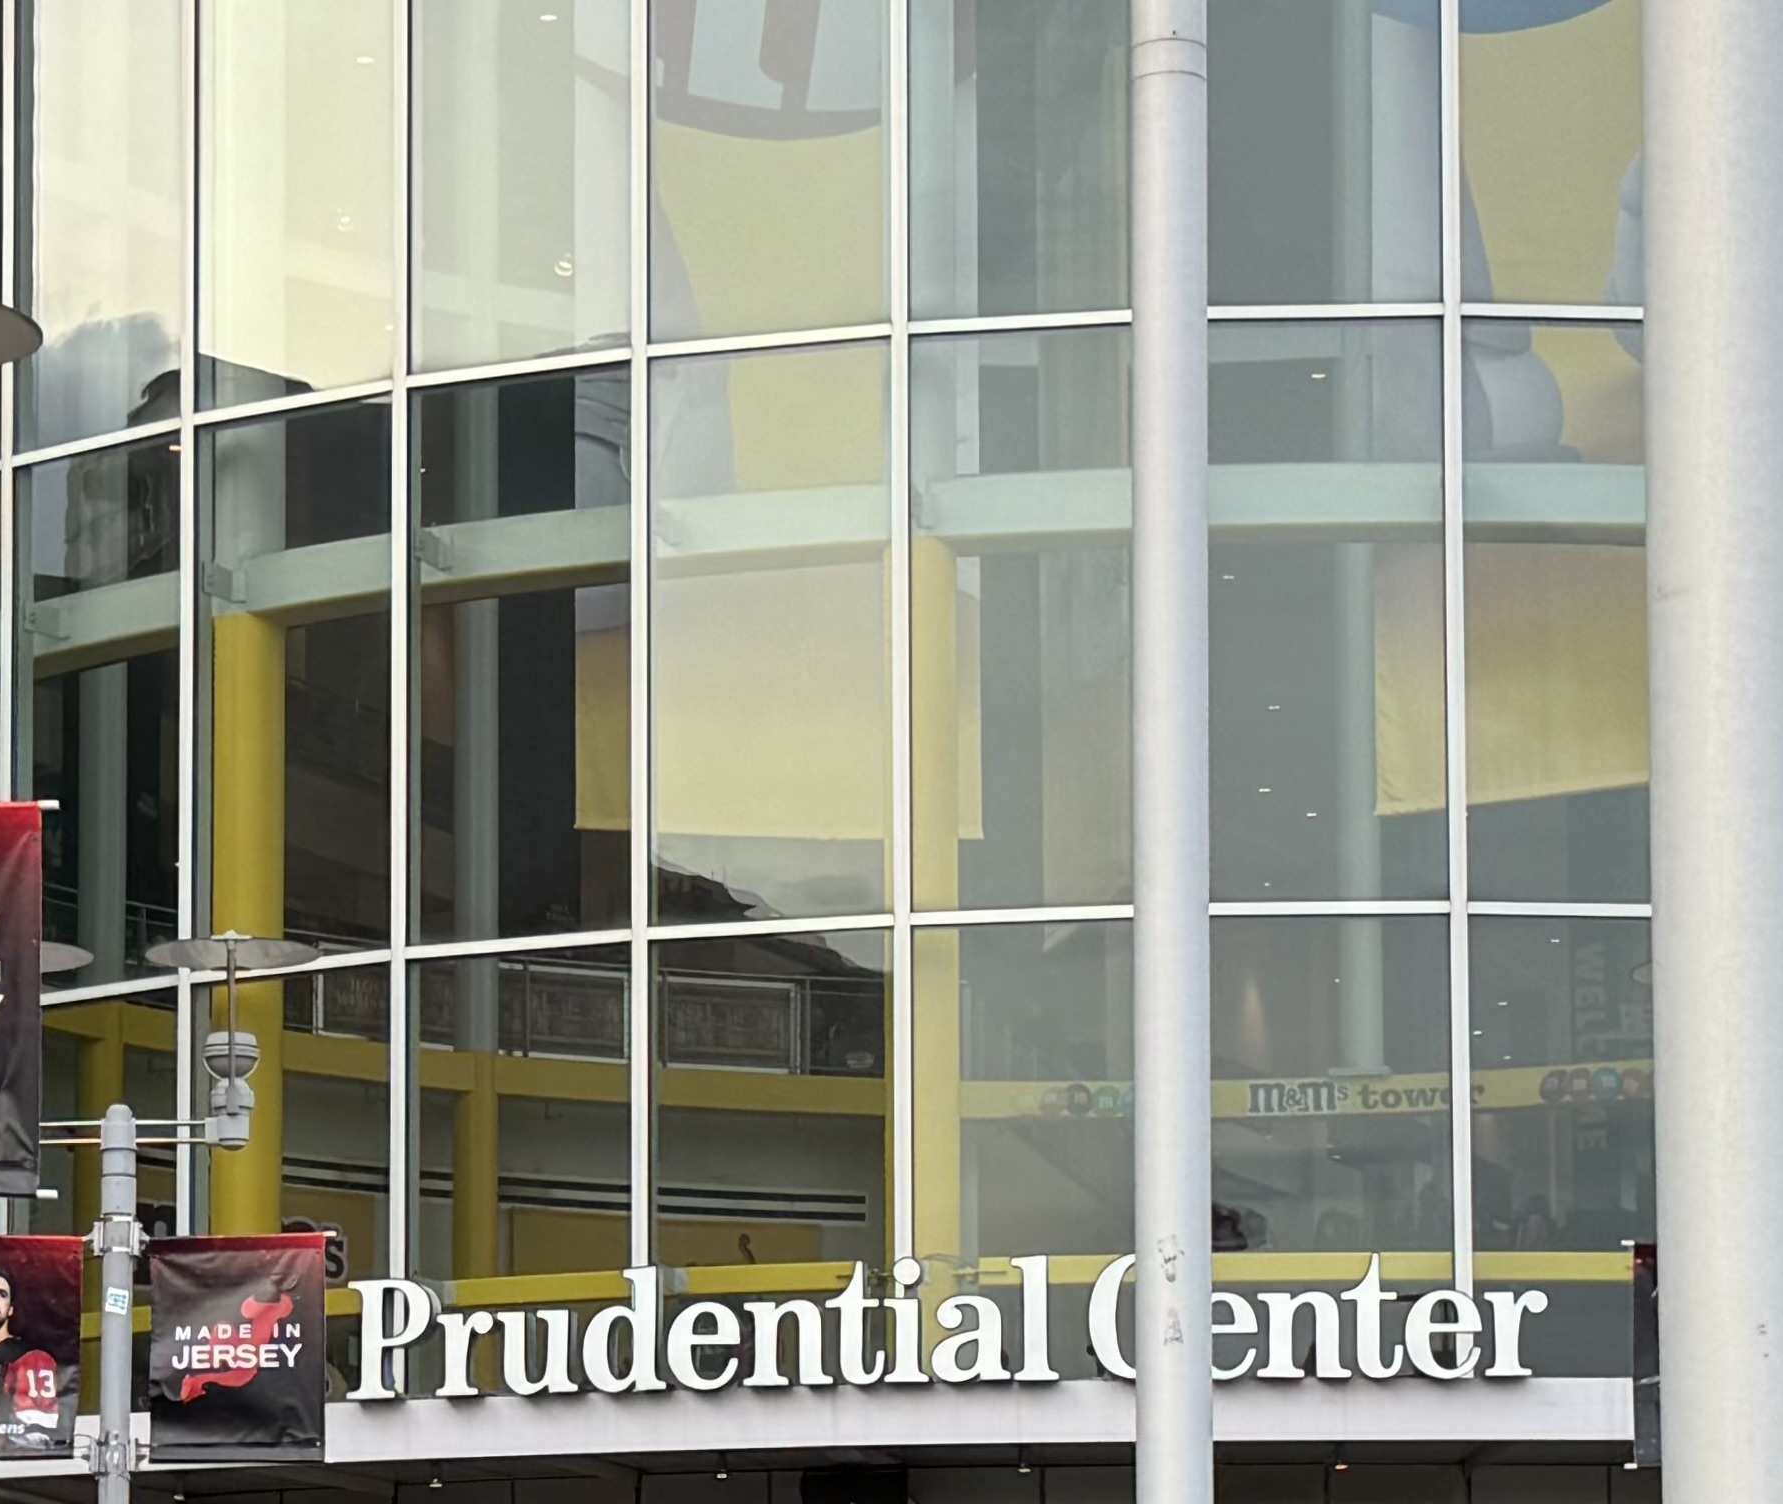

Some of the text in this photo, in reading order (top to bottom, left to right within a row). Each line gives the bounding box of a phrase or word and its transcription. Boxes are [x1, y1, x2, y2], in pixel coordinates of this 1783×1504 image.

[175, 1322, 302, 1341] MADE IN
[344, 1254, 1059, 1402] Prudential
[171, 1343, 303, 1370] JERSEY
[26, 1368, 57, 1398] 13
